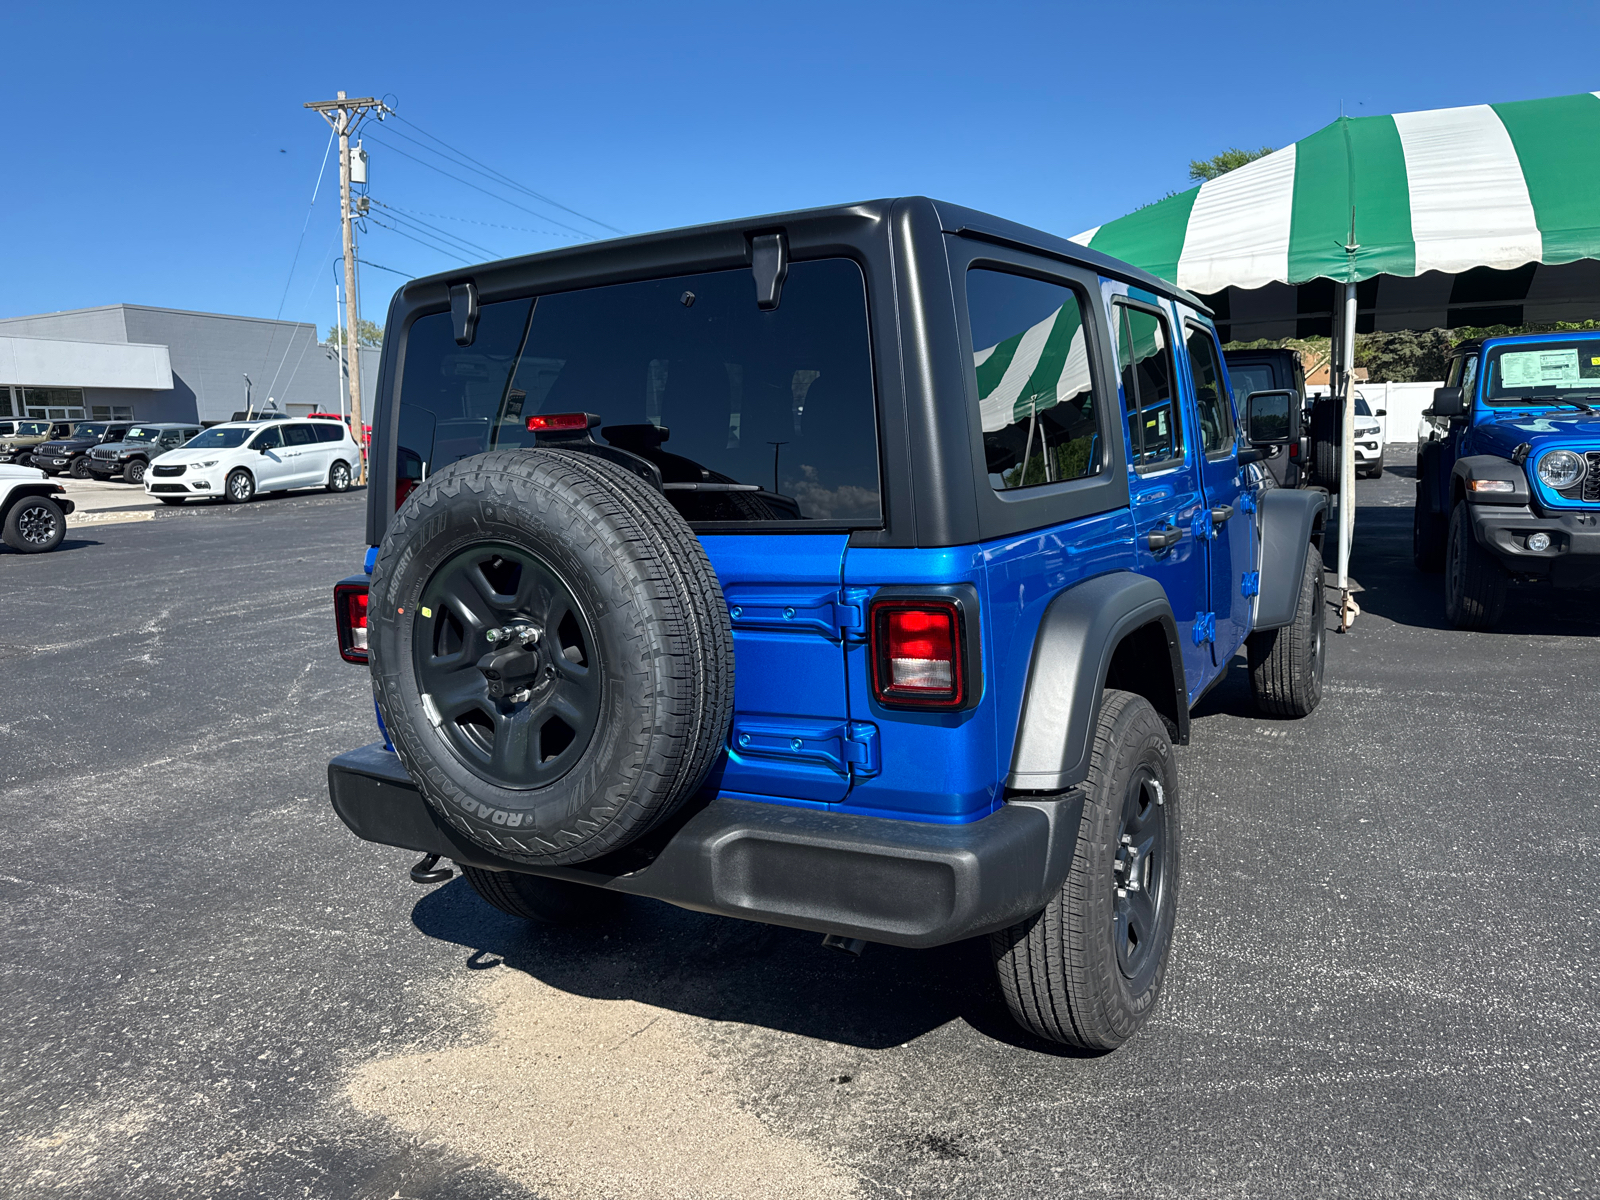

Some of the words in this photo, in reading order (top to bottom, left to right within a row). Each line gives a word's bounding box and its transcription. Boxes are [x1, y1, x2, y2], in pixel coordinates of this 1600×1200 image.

[386, 546, 413, 605] 245/75R17
[497, 505, 600, 602] NEXEN
[388, 692, 432, 768] HTX2
[426, 766, 524, 827] ROADIAN
